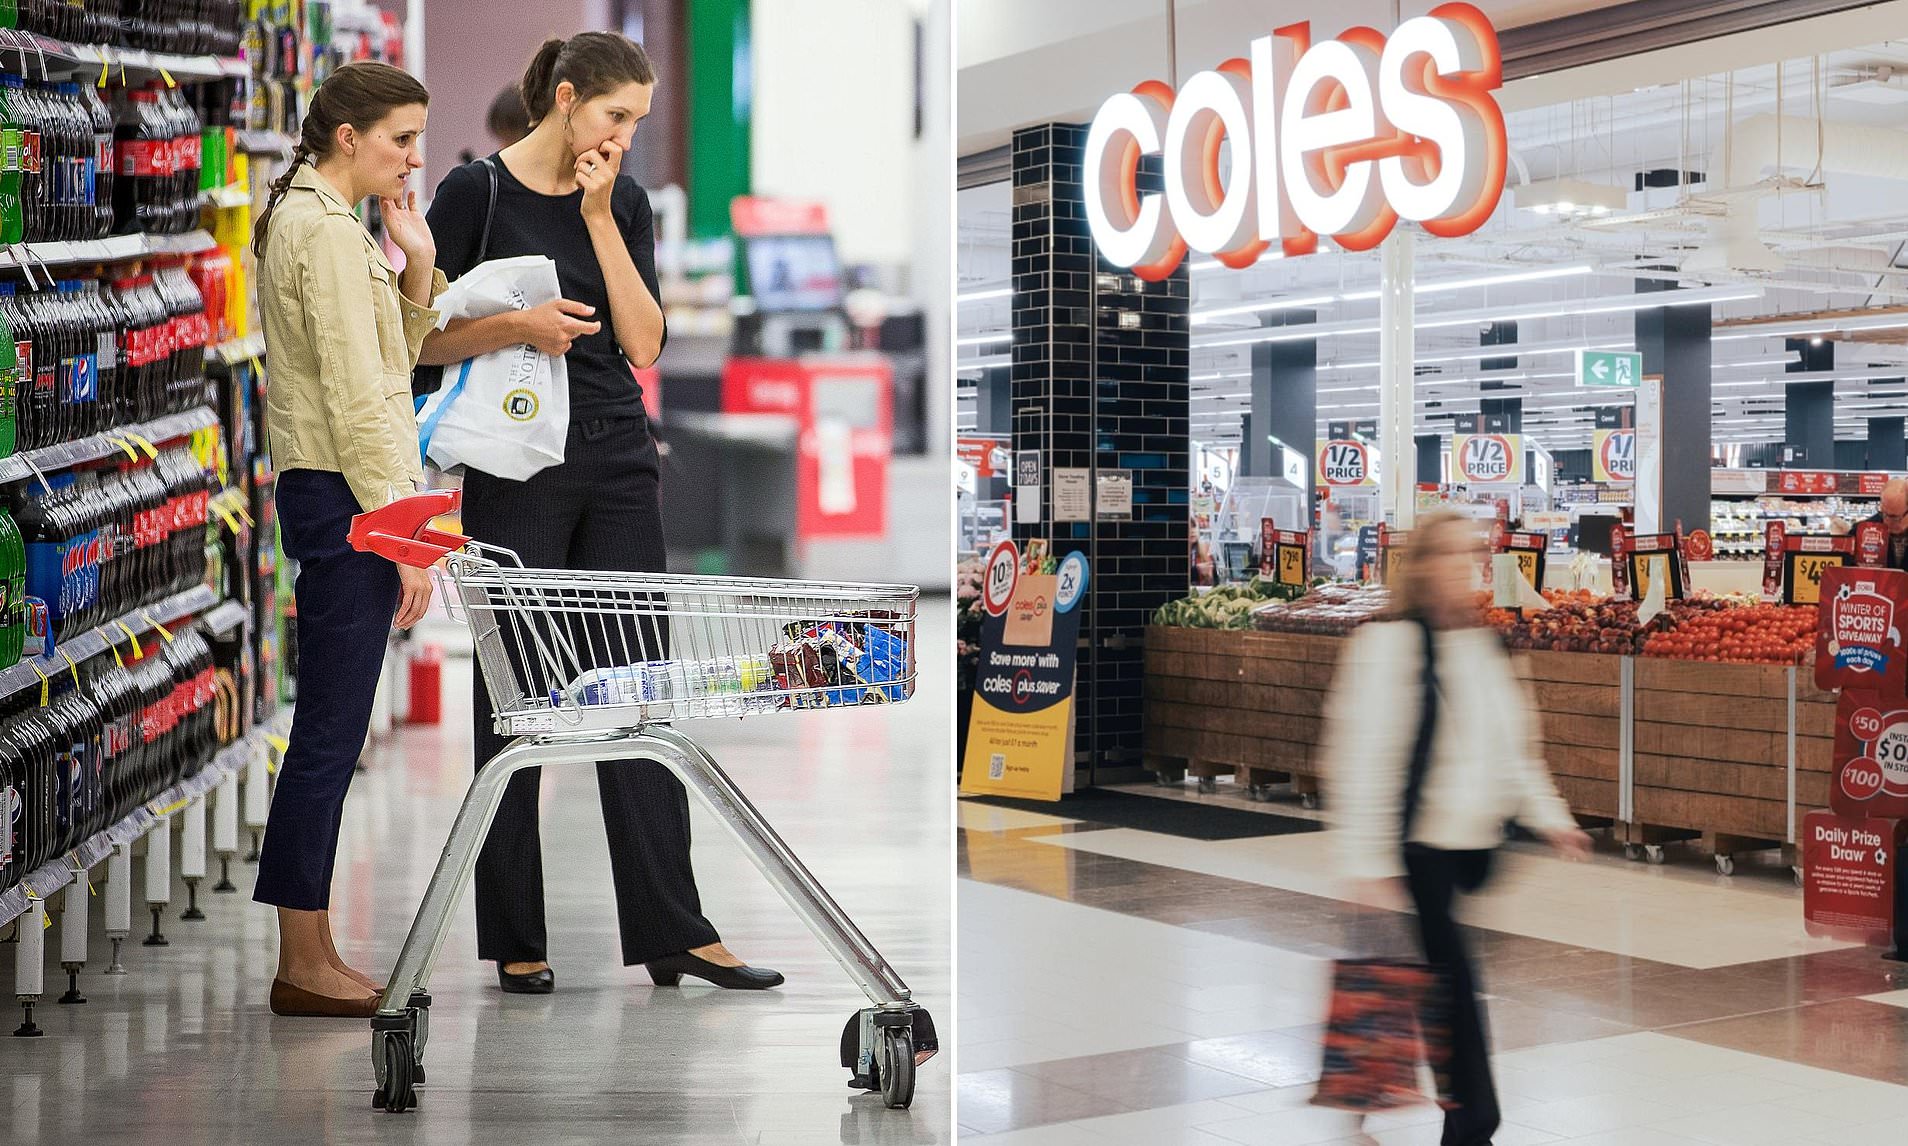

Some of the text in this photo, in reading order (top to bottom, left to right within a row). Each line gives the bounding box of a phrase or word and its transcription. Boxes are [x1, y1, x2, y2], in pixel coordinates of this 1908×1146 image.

[1084, 3, 1507, 280] coles
[518, 344, 537, 385] NOTR
[1469, 438, 1503, 462] 1/2
[1611, 434, 1635, 459] 1/
[1328, 446, 1361, 467] 1/2
[1020, 460, 1038, 473] OPEN
[1327, 467, 1363, 479] PRICE
[1467, 461, 1506, 474] PRICE
[1609, 459, 1634, 472] PRI
[1840, 602, 1886, 616] WINTER OF
[1839, 615, 1884, 631] SPORTS
[1839, 631, 1882, 643] GIVEAWAY
[990, 651, 1011, 665] Save
[1038, 653, 1060, 669] with
[983, 674, 1061, 695] coles plus saver
[1855, 715, 1880, 732] $50
[1889, 732, 1908, 743] INST
[1845, 768, 1880, 788] $100
[1815, 826, 1881, 847] Daily Prize
